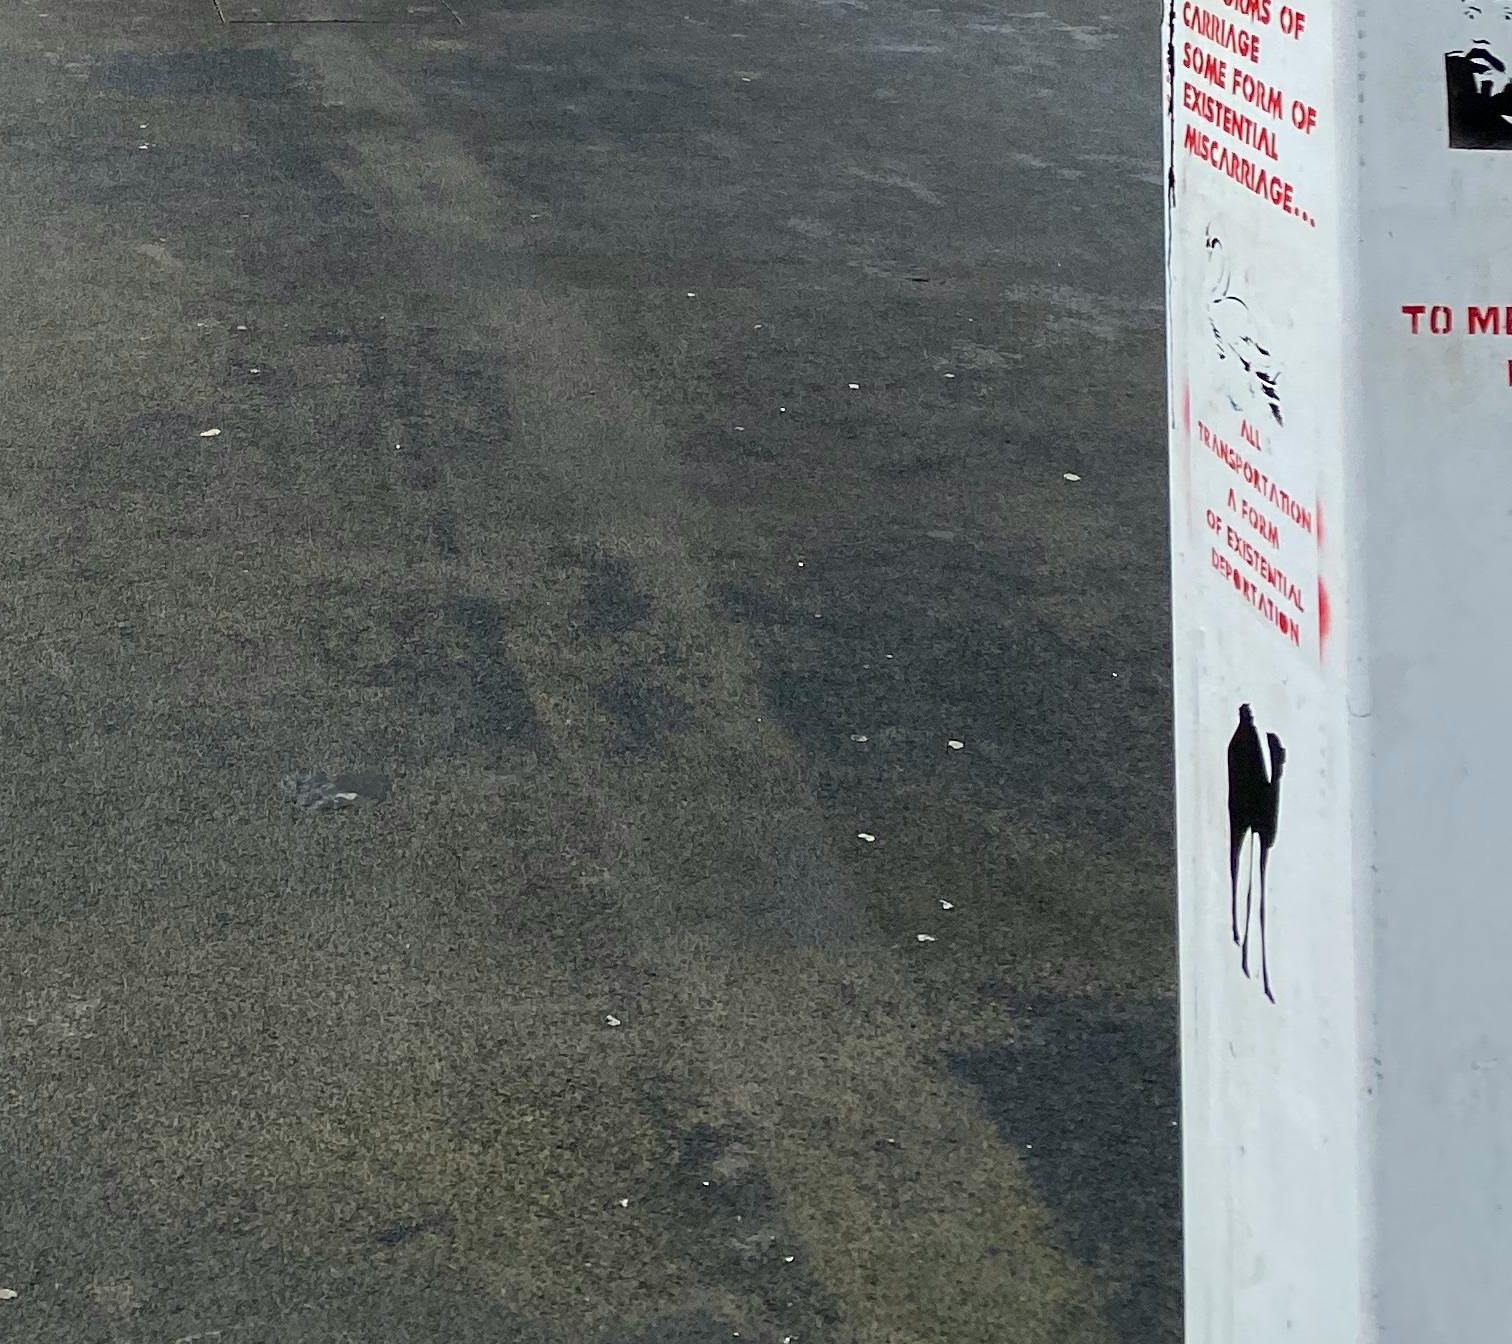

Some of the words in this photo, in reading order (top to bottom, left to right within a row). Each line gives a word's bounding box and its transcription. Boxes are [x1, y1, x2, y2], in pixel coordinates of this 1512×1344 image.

[1182, 0, 1261, 64] CARRIAGE
[1279, 4, 1306, 41] OF
[1182, 41, 1227, 90] SOME
[1232, 67, 1284, 121] FORM
[1291, 99, 1318, 135] OF
[1183, 80, 1279, 162] EXISTENTIAL
[1183, 122, 1317, 228] MISCARRIAGE...
[1401, 305, 1453, 335] TO
[1240, 418, 1263, 452] ALL
[1197, 419, 1313, 534] TRANSPORTATION
[1226, 486, 1238, 513] A
[1241, 498, 1280, 550] FORM
[1206, 508, 1223, 536] OF
[1226, 524, 1305, 614] EXISTENTIAL
[1210, 546, 1301, 648] DEPORTATION
